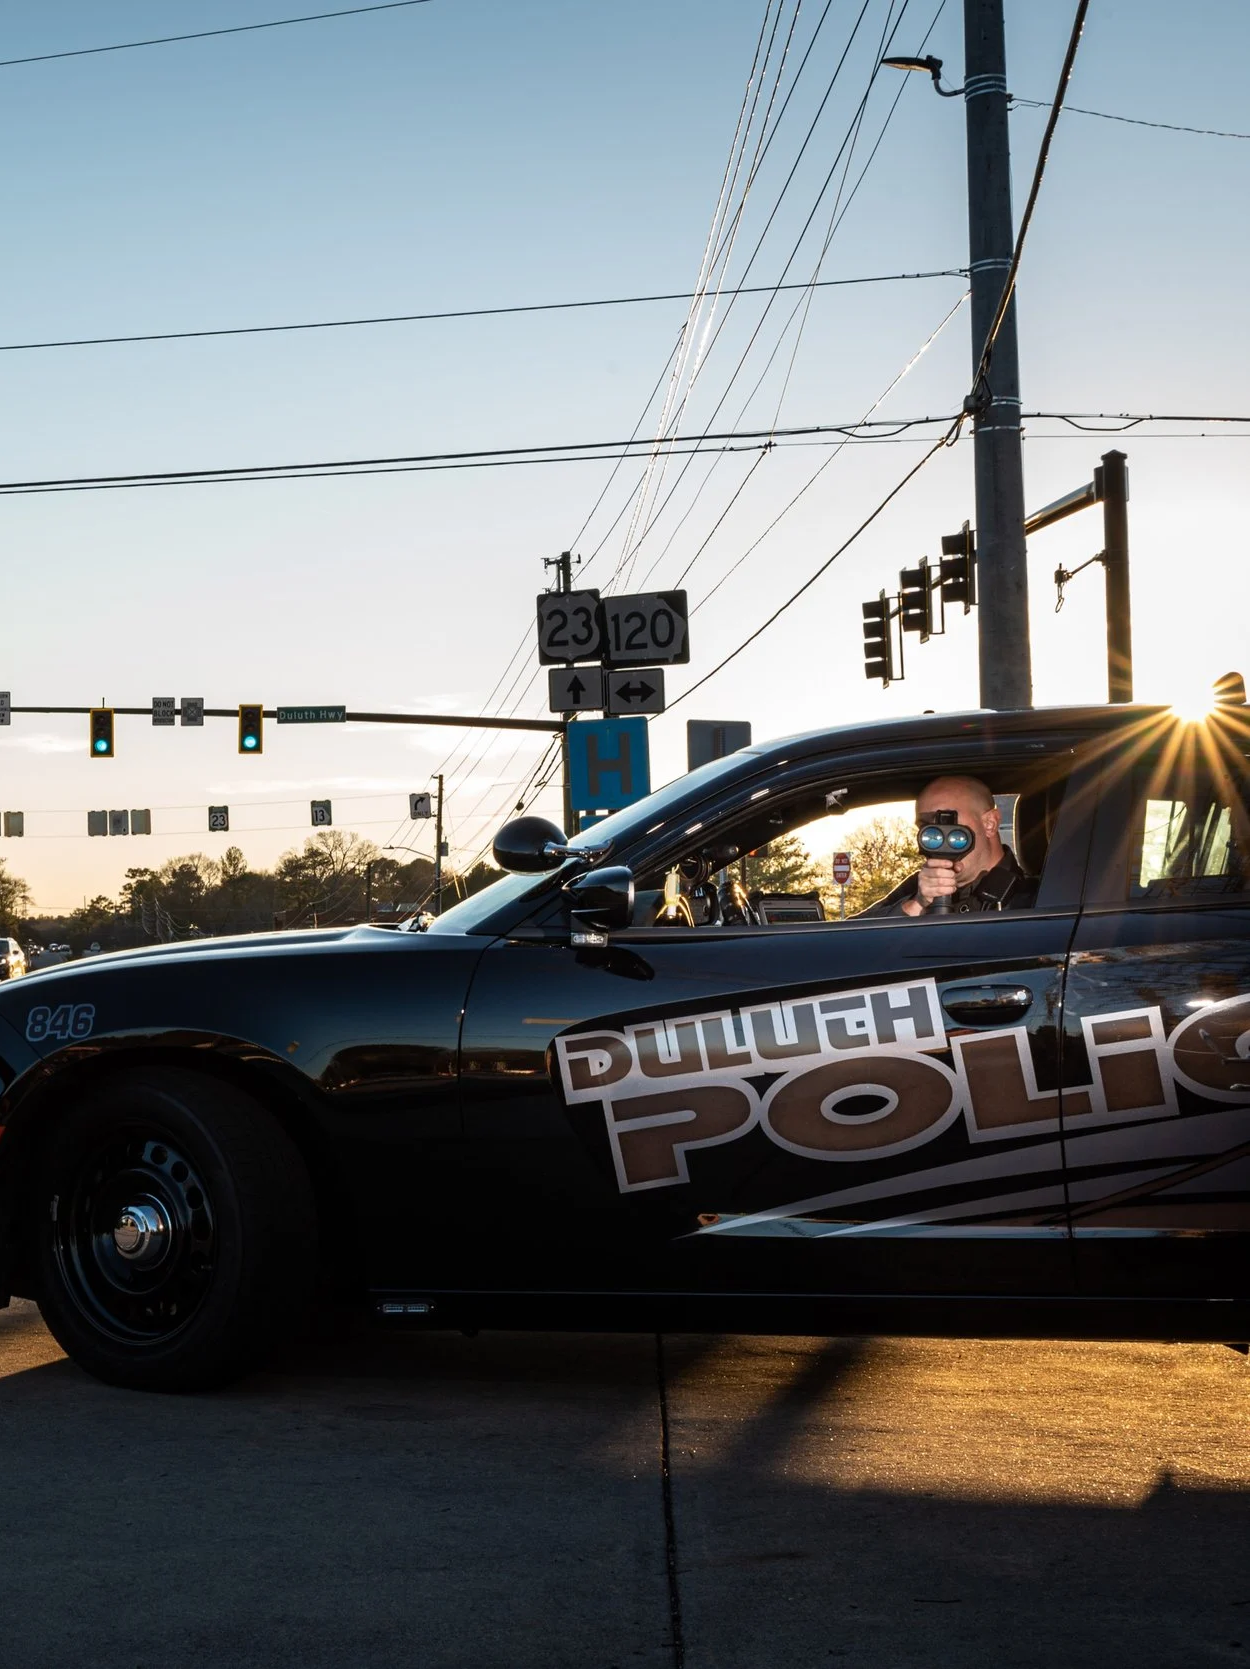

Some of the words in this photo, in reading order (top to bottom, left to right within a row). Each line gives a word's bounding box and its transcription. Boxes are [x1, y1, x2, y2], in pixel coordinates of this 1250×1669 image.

[546, 606, 593, 647] 23
[611, 608, 675, 651] 120
[279, 710, 316, 720] Duluth
[319, 710, 343, 720] Hwy
[586, 731, 633, 796] H
[211, 814, 227, 827] 23
[314, 809, 325, 822] 13
[26, 1004, 95, 1042] 846
